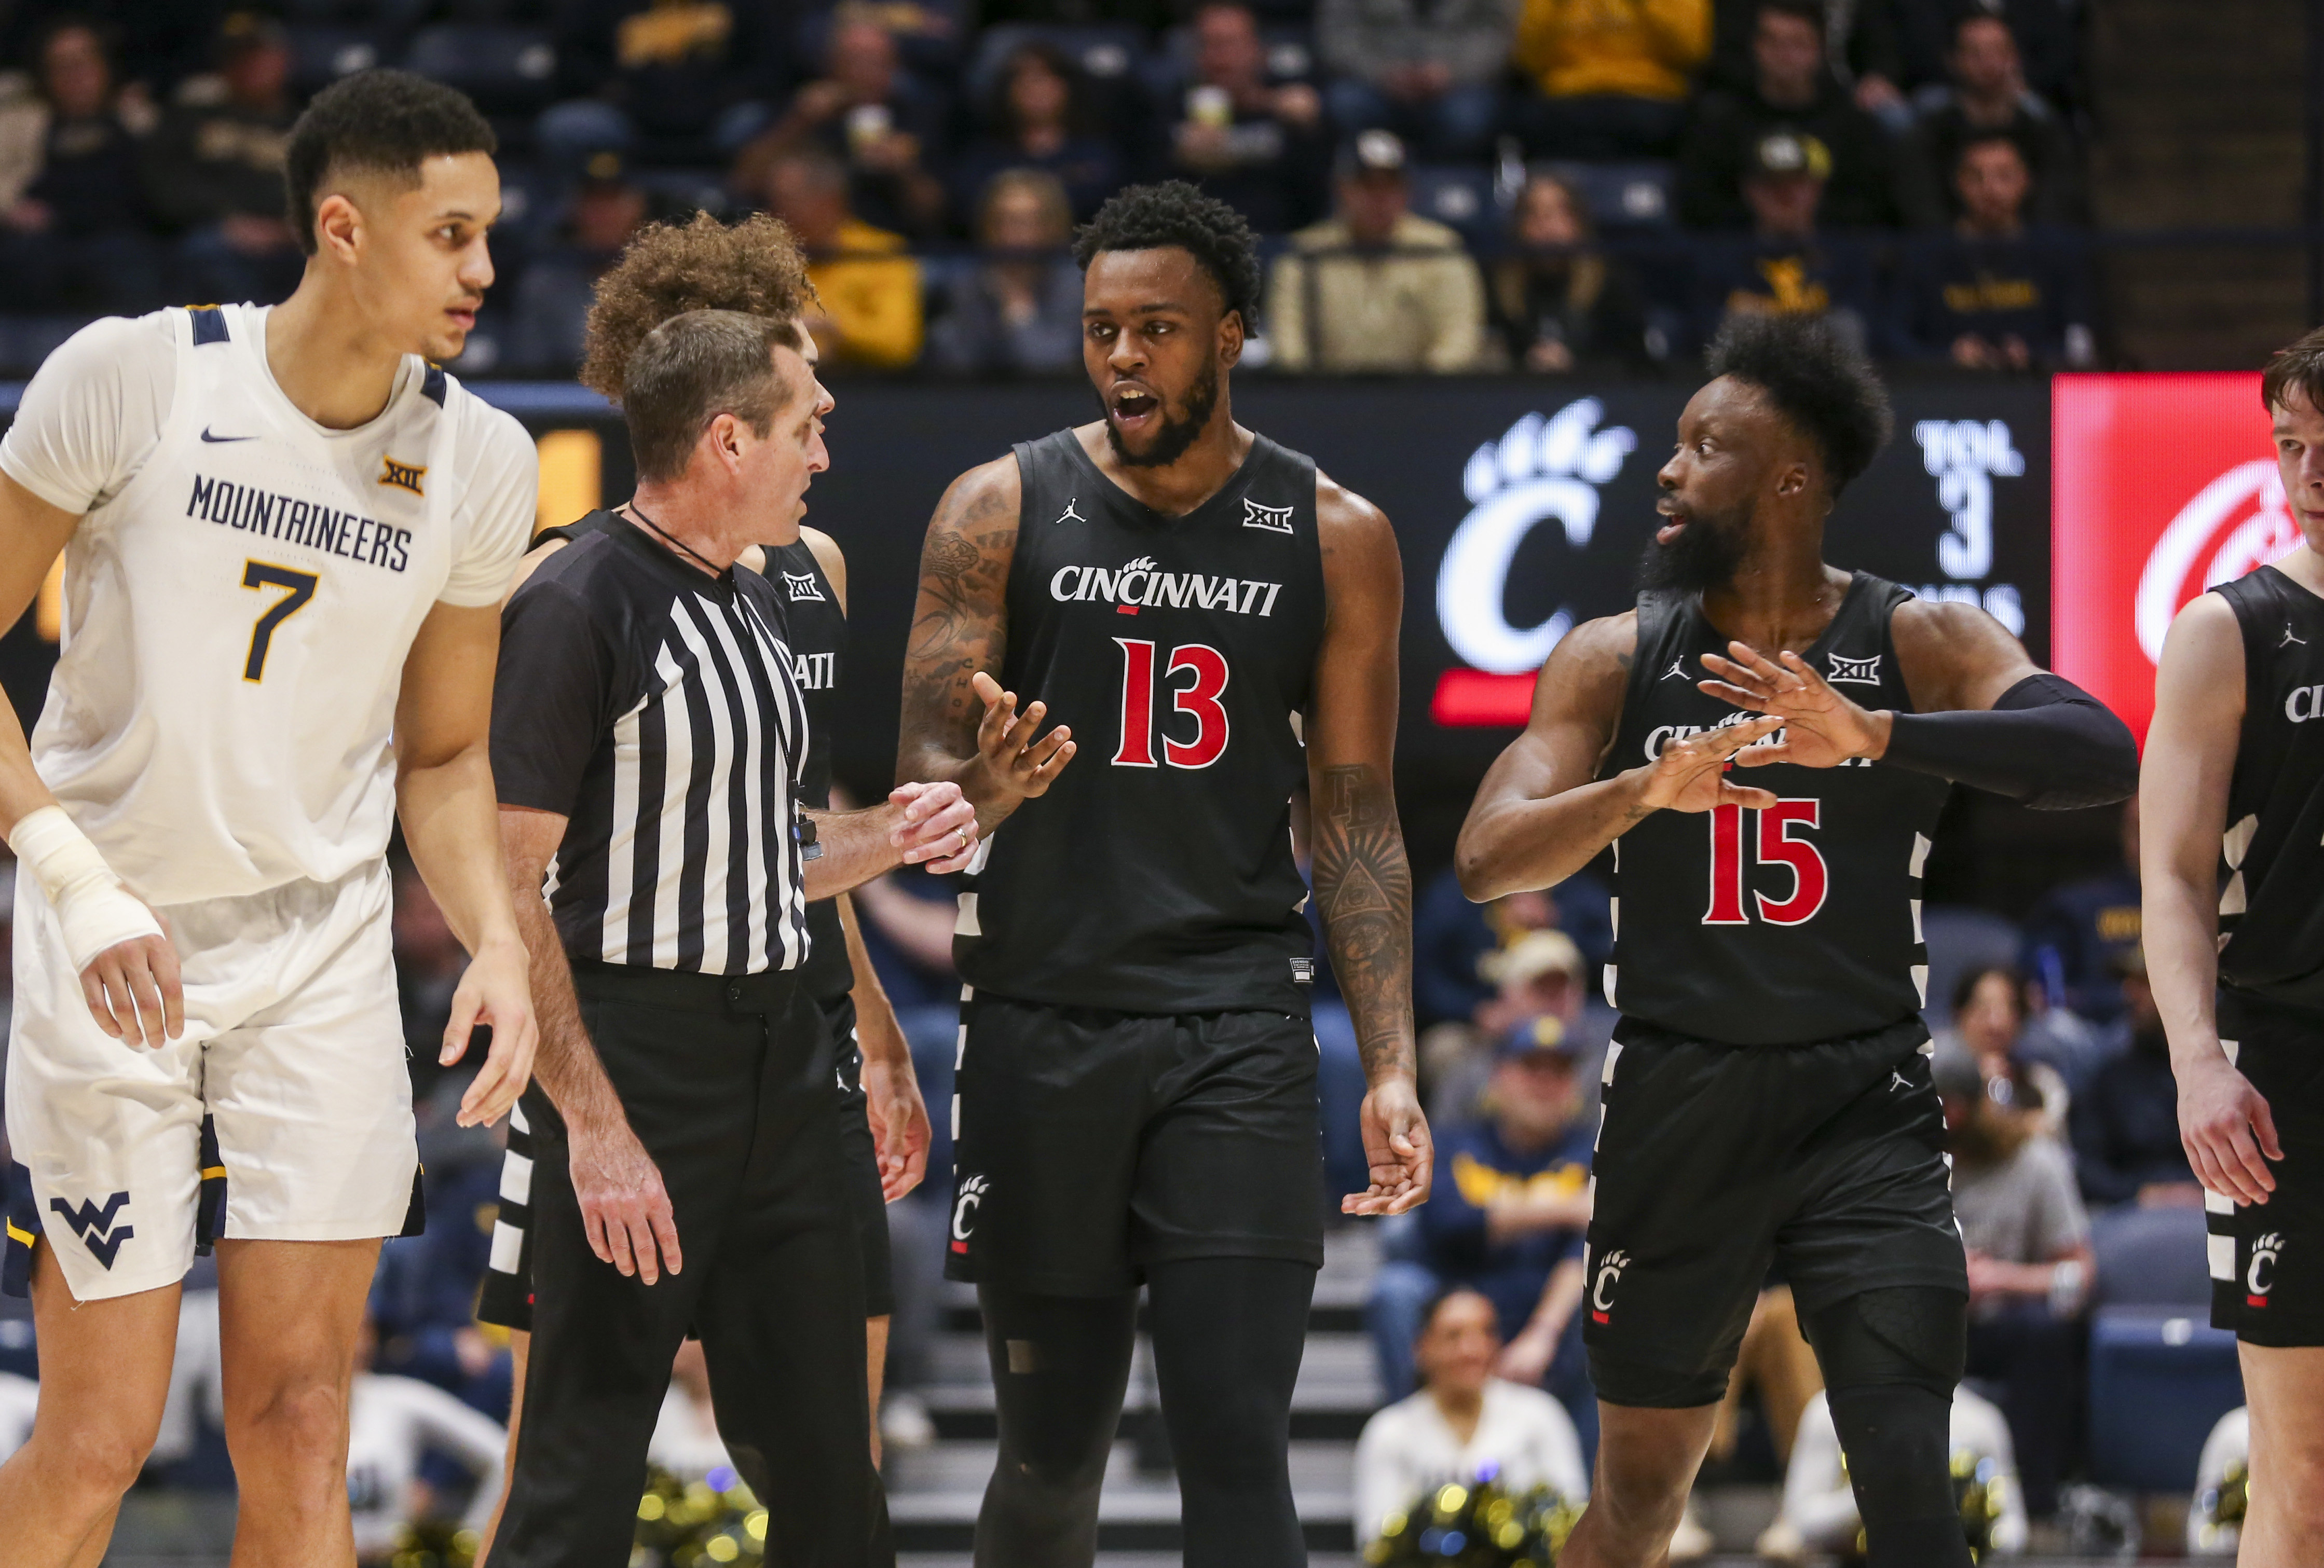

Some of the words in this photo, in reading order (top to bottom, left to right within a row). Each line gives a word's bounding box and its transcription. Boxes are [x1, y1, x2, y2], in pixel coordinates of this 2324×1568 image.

[186, 473, 412, 573] MOUNTAINEERS
[240, 558, 320, 684] 7
[1050, 556, 1283, 616] CINCINNATI
[793, 652, 835, 690] ATI
[1111, 636, 1230, 769] 13
[2285, 685, 2324, 723] CI
[1702, 798, 1828, 926] 15
